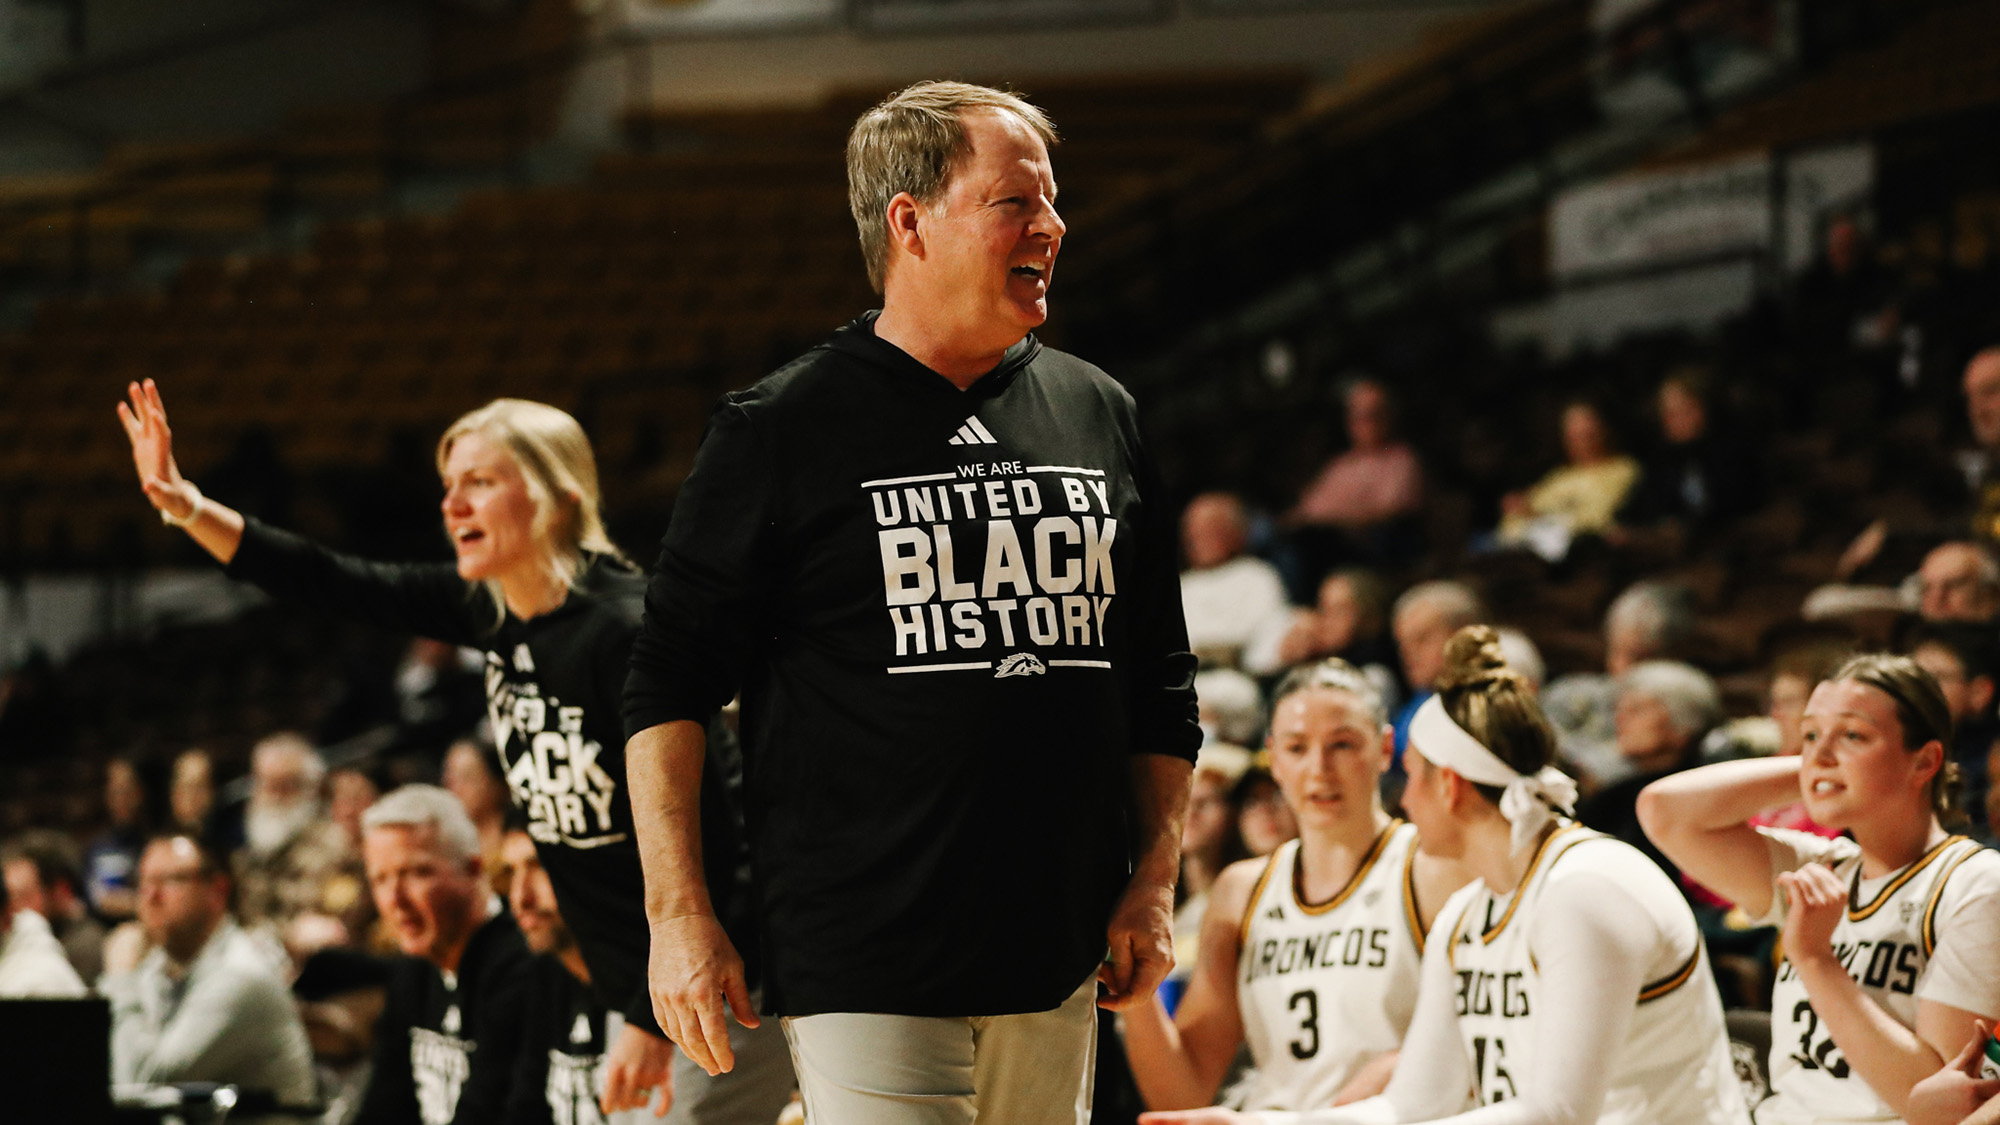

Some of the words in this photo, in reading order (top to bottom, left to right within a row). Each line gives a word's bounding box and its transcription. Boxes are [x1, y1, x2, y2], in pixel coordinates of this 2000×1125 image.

[957, 463, 986, 478] WE
[990, 461, 1023, 476] ARE
[871, 478, 1042, 526] UNITED
[1061, 477, 1111, 515] BY
[878, 515, 1117, 606] BLACK
[889, 595, 1112, 656] HISTORY
[1246, 928, 1389, 984] RONCOS
[1288, 988, 1320, 1060] 3
